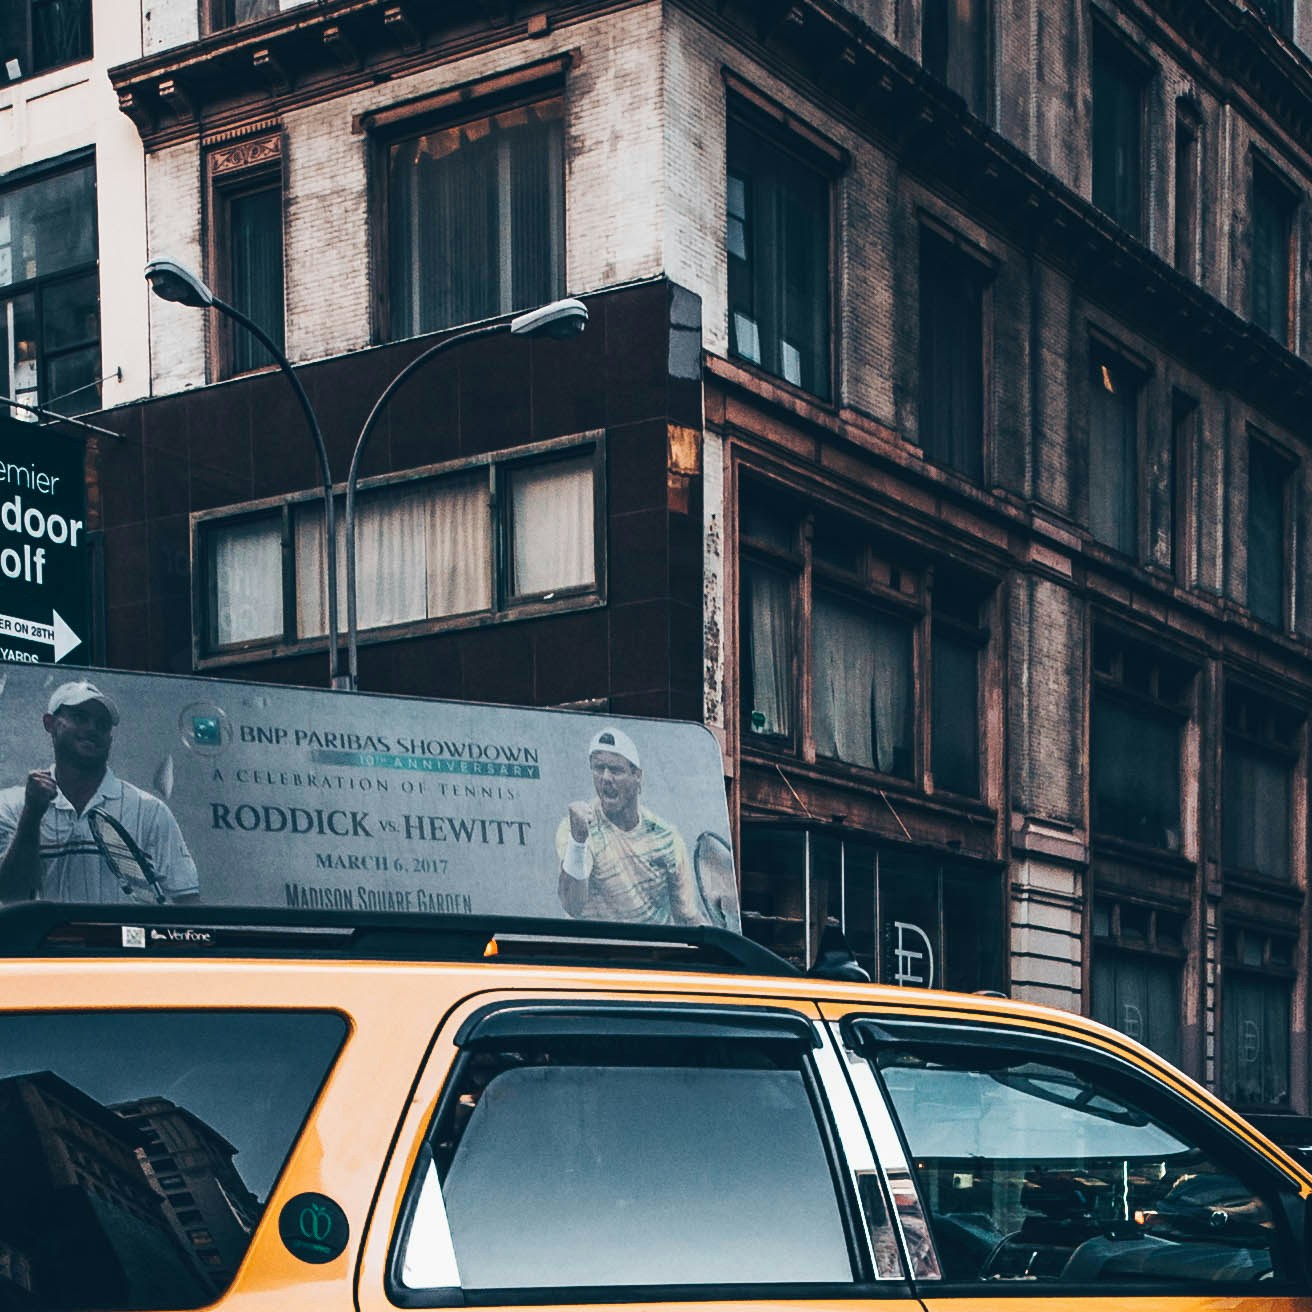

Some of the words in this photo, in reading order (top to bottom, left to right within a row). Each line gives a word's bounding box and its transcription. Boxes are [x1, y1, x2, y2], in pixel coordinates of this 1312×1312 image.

[14, 622, 28, 635] ON
[31, 626, 55, 640] 28TH
[0, 647, 39, 663] YARDS
[240, 725, 288, 745] BNP
[294, 729, 390, 752] PARIBAS
[396, 737, 539, 763] SHOWDOWN
[393, 758, 536, 778] ANNIVERSARY
[213, 769, 224, 783] A
[237, 770, 389, 793] CELEBRATION
[402, 781, 426, 795] OF
[440, 784, 516, 800] TENNIS
[210, 803, 375, 838] RODDICK
[403, 814, 532, 846] HEWITT
[315, 853, 388, 872] MARCH
[393, 856, 408, 874] 6,
[413, 858, 448, 874] 2017
[285, 882, 352, 910] MADISON
[357, 885, 412, 911] SQUARE
[417, 889, 473, 914] GARDEN
